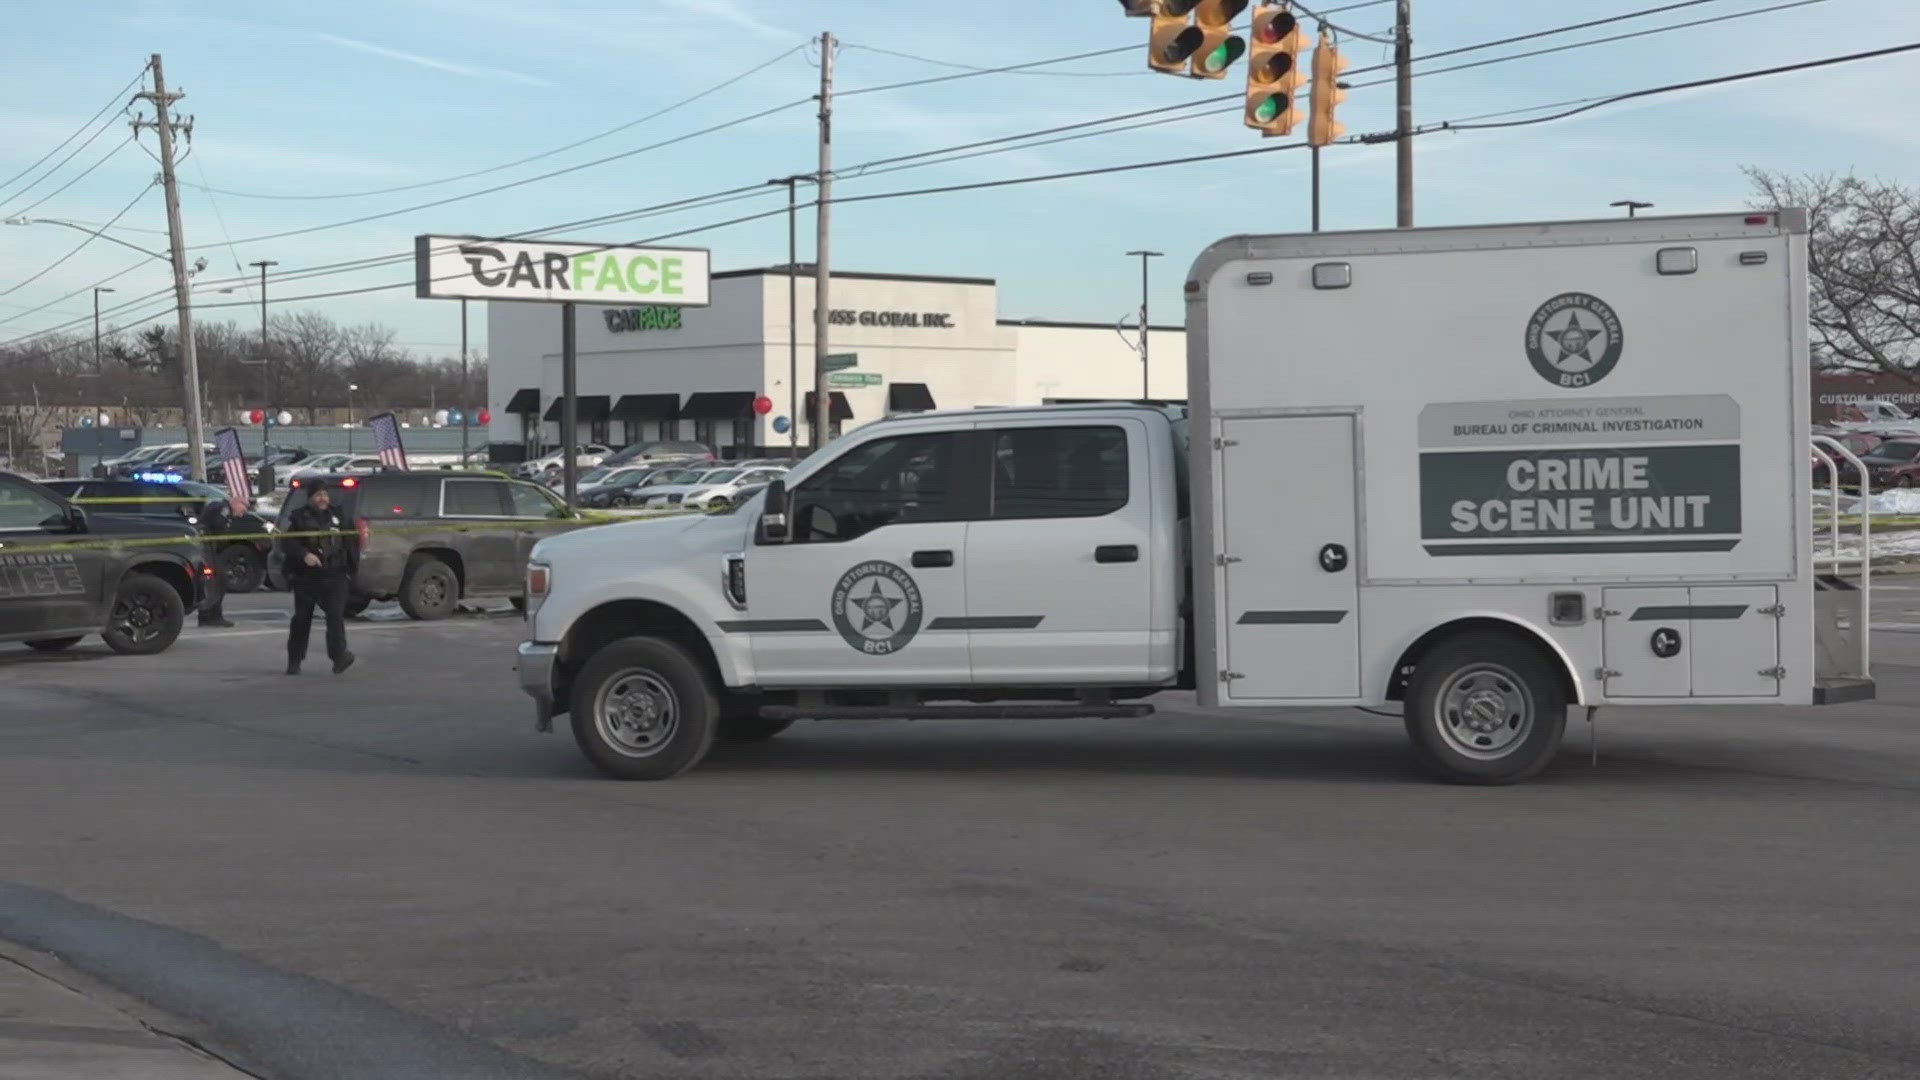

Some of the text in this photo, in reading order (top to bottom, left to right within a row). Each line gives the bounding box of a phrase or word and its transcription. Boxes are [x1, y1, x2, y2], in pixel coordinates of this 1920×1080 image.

[458, 245, 684, 294] CARFACE
[602, 306, 682, 333] CARFACE
[859, 311, 921, 328] GLOBAL
[923, 313, 956, 329] INC.
[1529, 295, 1620, 349] OHIO ATTORNEY GENERAL
[1560, 372, 1591, 386] BCI
[1819, 394, 1867, 405] CUSTOM
[1508, 406, 1644, 420] OHIO ATTORNEY GENERAL
[1453, 418, 1703, 436] BUREAU OF CRIMINAL INVESTIGATION
[1507, 456, 1650, 492] CRIME
[1450, 495, 1710, 532] SCENE UNIT
[834, 564, 920, 616] OHIO ATTORNEY GENERAL
[864, 640, 893, 653] BCI
